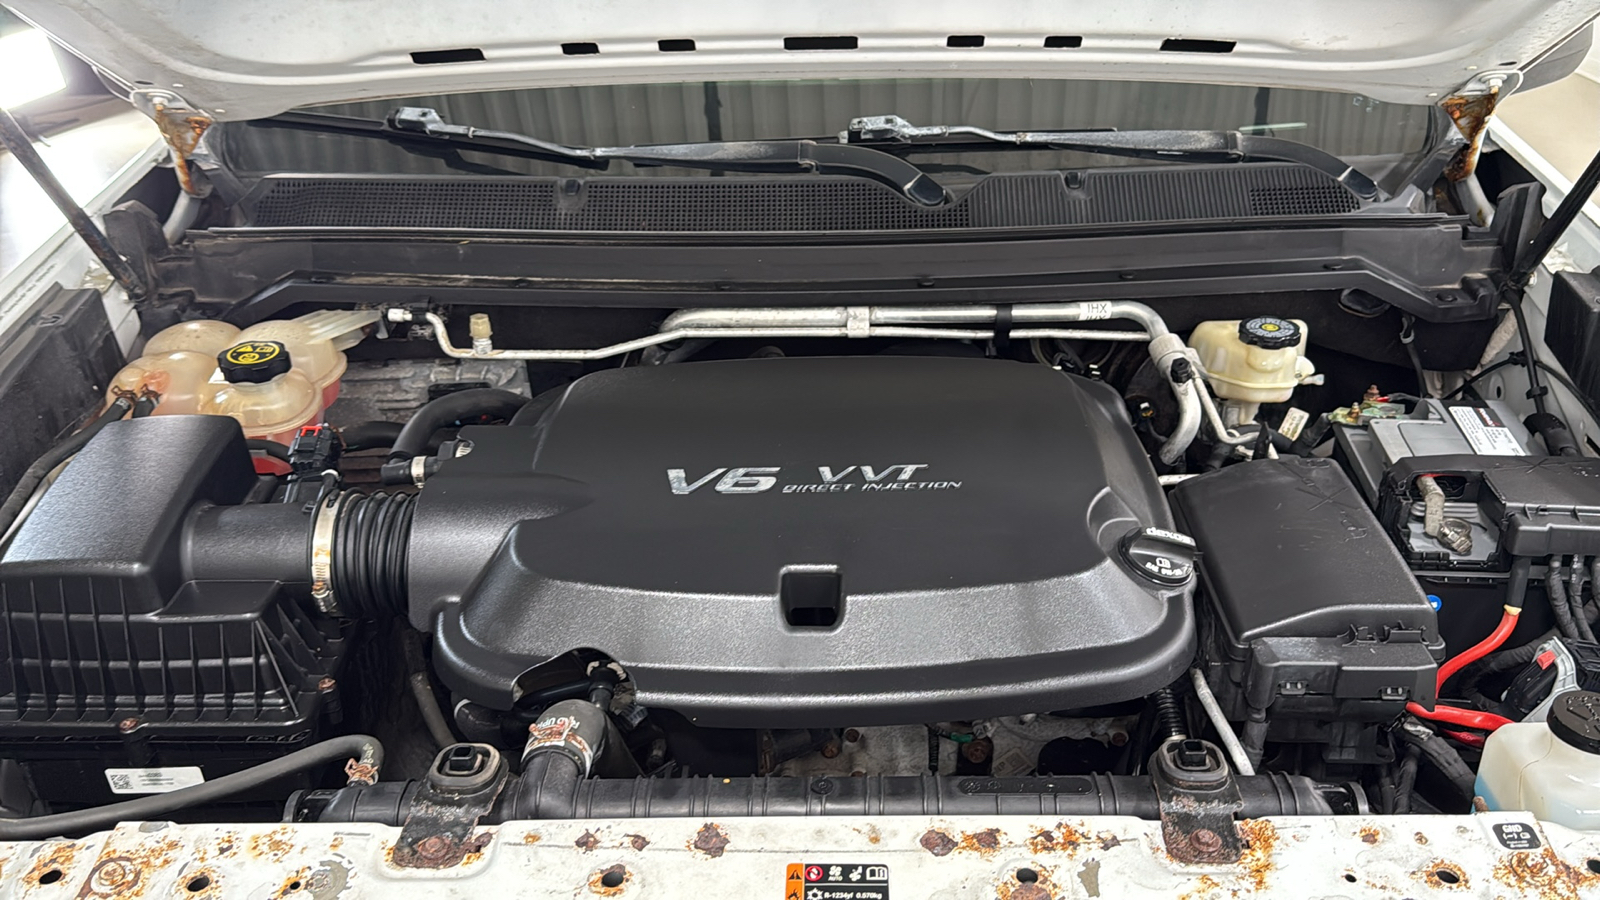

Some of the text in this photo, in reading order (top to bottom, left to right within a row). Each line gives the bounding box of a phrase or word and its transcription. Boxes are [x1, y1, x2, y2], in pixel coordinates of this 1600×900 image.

[667, 463, 930, 495] V6 VVT
[782, 480, 963, 494] DIRECT INJECTION
